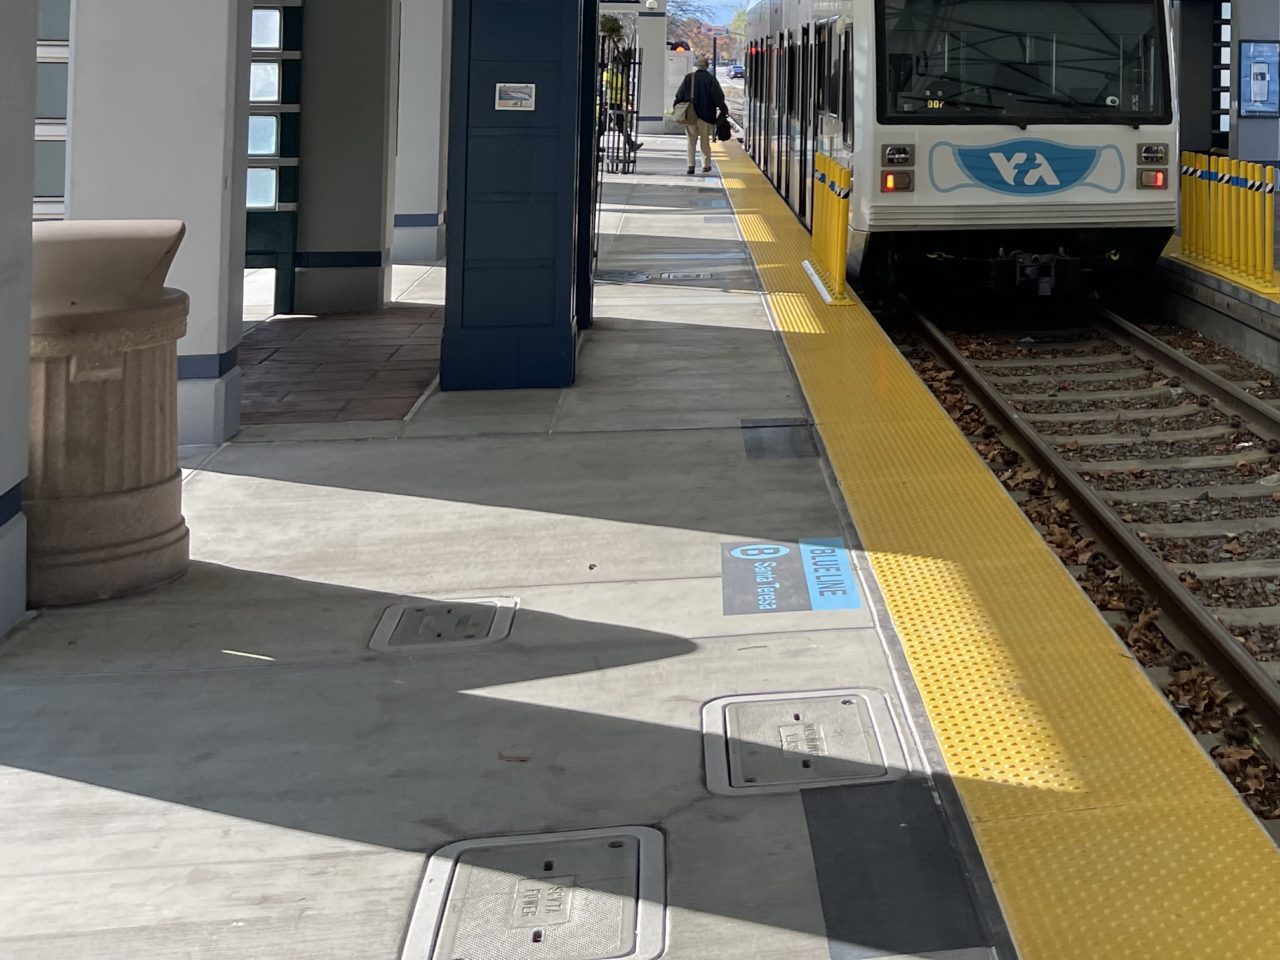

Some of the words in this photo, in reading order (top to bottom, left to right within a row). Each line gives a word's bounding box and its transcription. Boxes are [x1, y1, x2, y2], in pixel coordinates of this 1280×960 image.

[988, 152, 1061, 186] VTA
[740, 547, 780, 557] B
[810, 548, 842, 573] BLUE
[754, 561, 777, 582] Santa
[756, 583, 781, 610] Teresa
[815, 573, 848, 597] LINE
